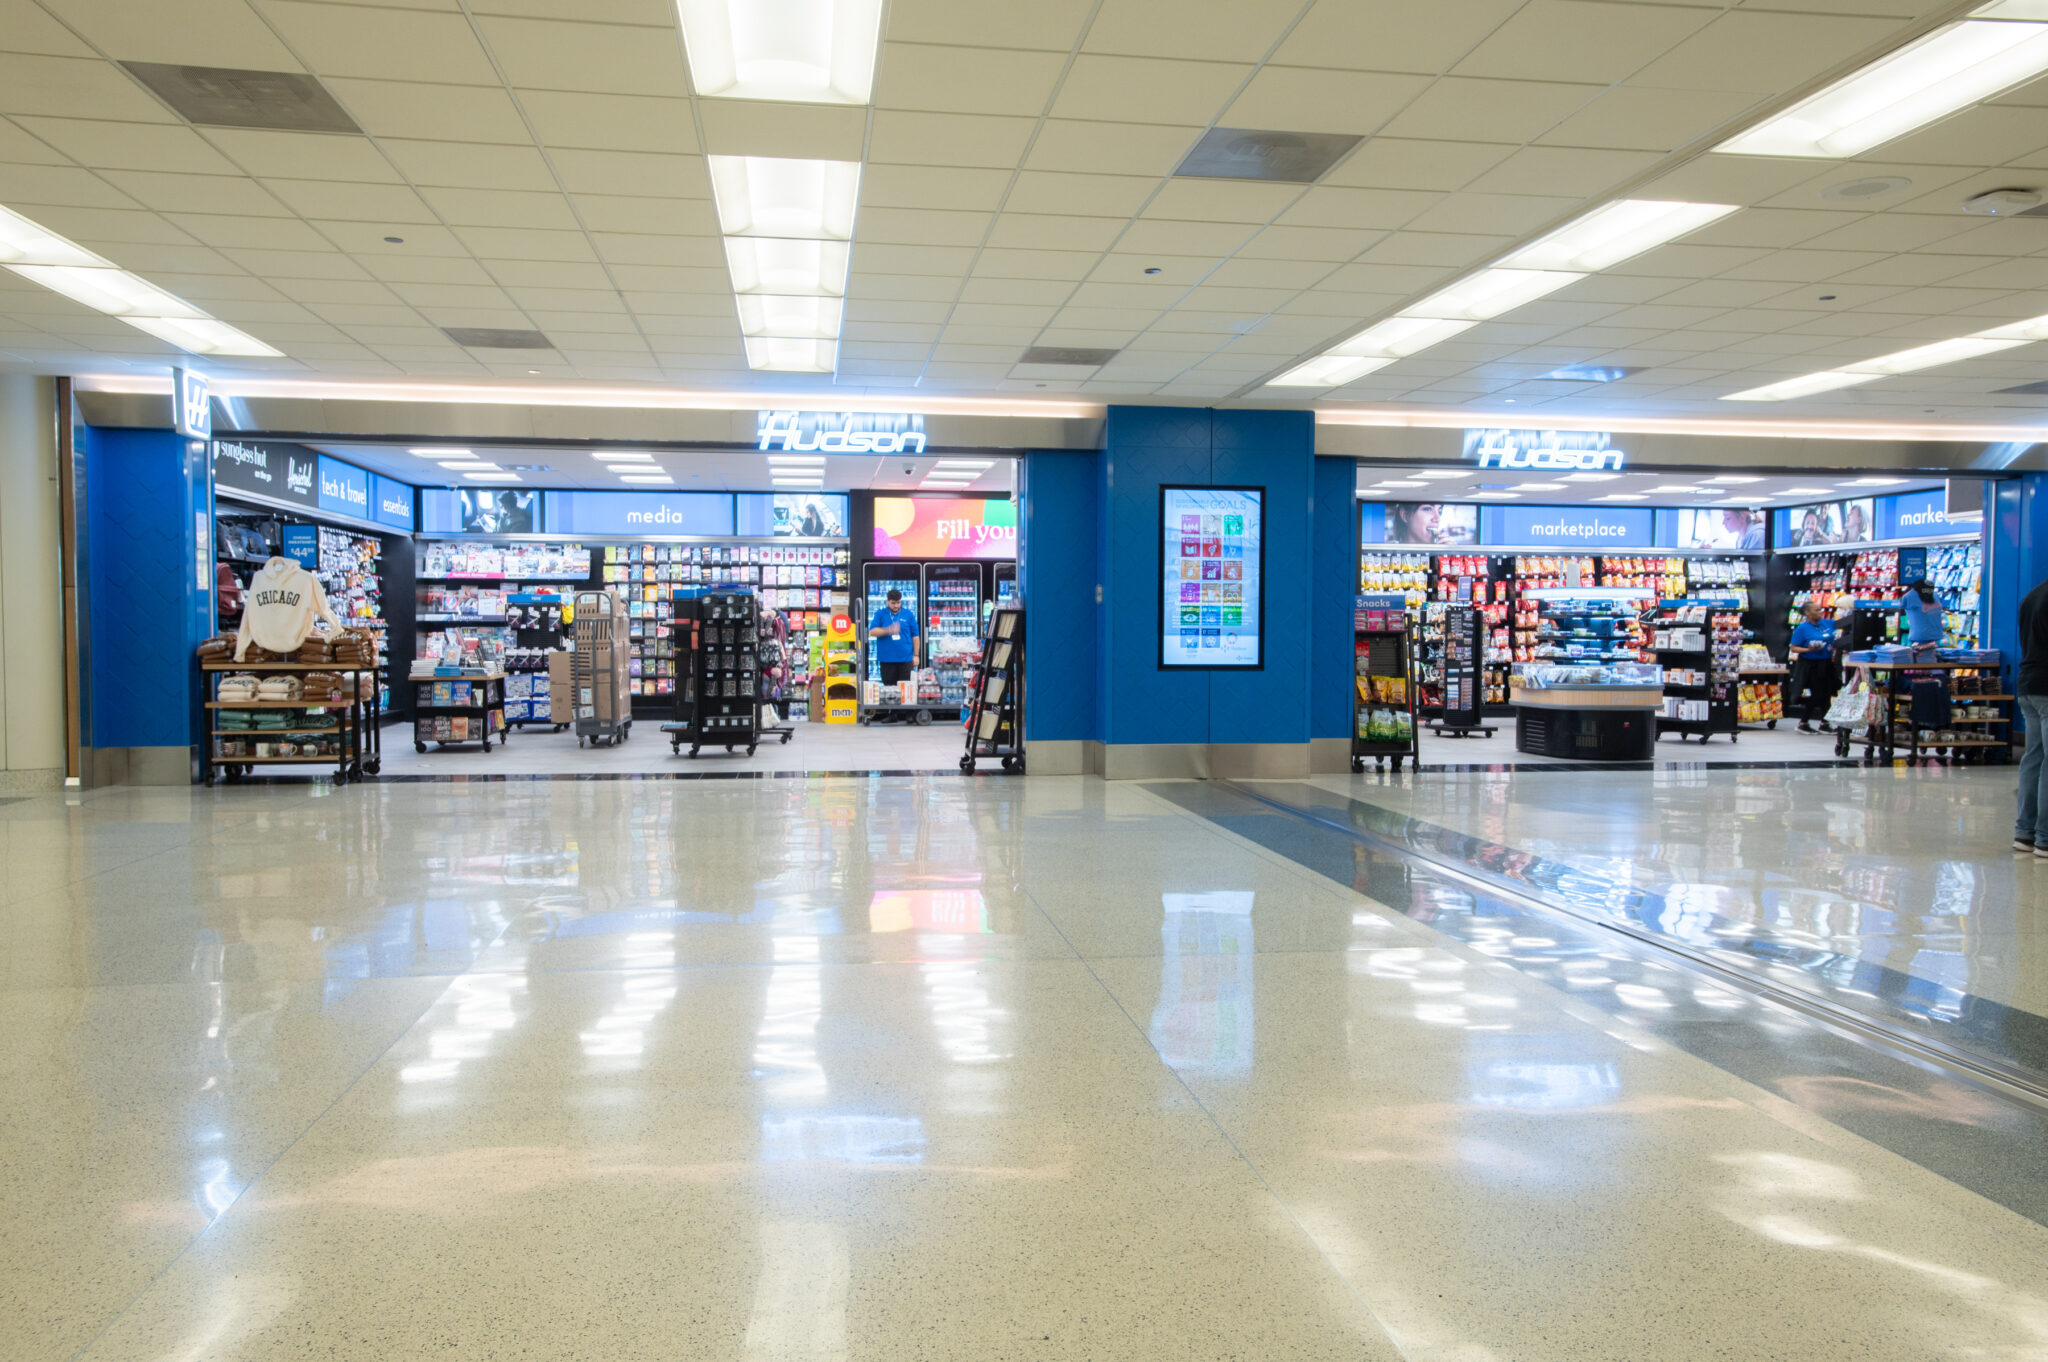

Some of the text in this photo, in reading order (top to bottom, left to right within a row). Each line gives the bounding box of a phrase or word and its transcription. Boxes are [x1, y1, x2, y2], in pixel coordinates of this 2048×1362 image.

[757, 415, 927, 453] Hudson
[220, 441, 267, 468] sunglass hut
[1477, 435, 1625, 470] Hudson
[322, 471, 368, 506] tech & travel
[383, 495, 410, 518] essentials
[627, 504, 683, 523] media
[1210, 499, 1247, 510] GOALS
[1900, 503, 1946, 527] marke
[936, 519, 971, 540] Fill
[1531, 518, 1627, 539] marketplace
[256, 590, 301, 607] CHICAGO
[1356, 599, 1391, 608] Snacks
[835, 617, 848, 629] m
